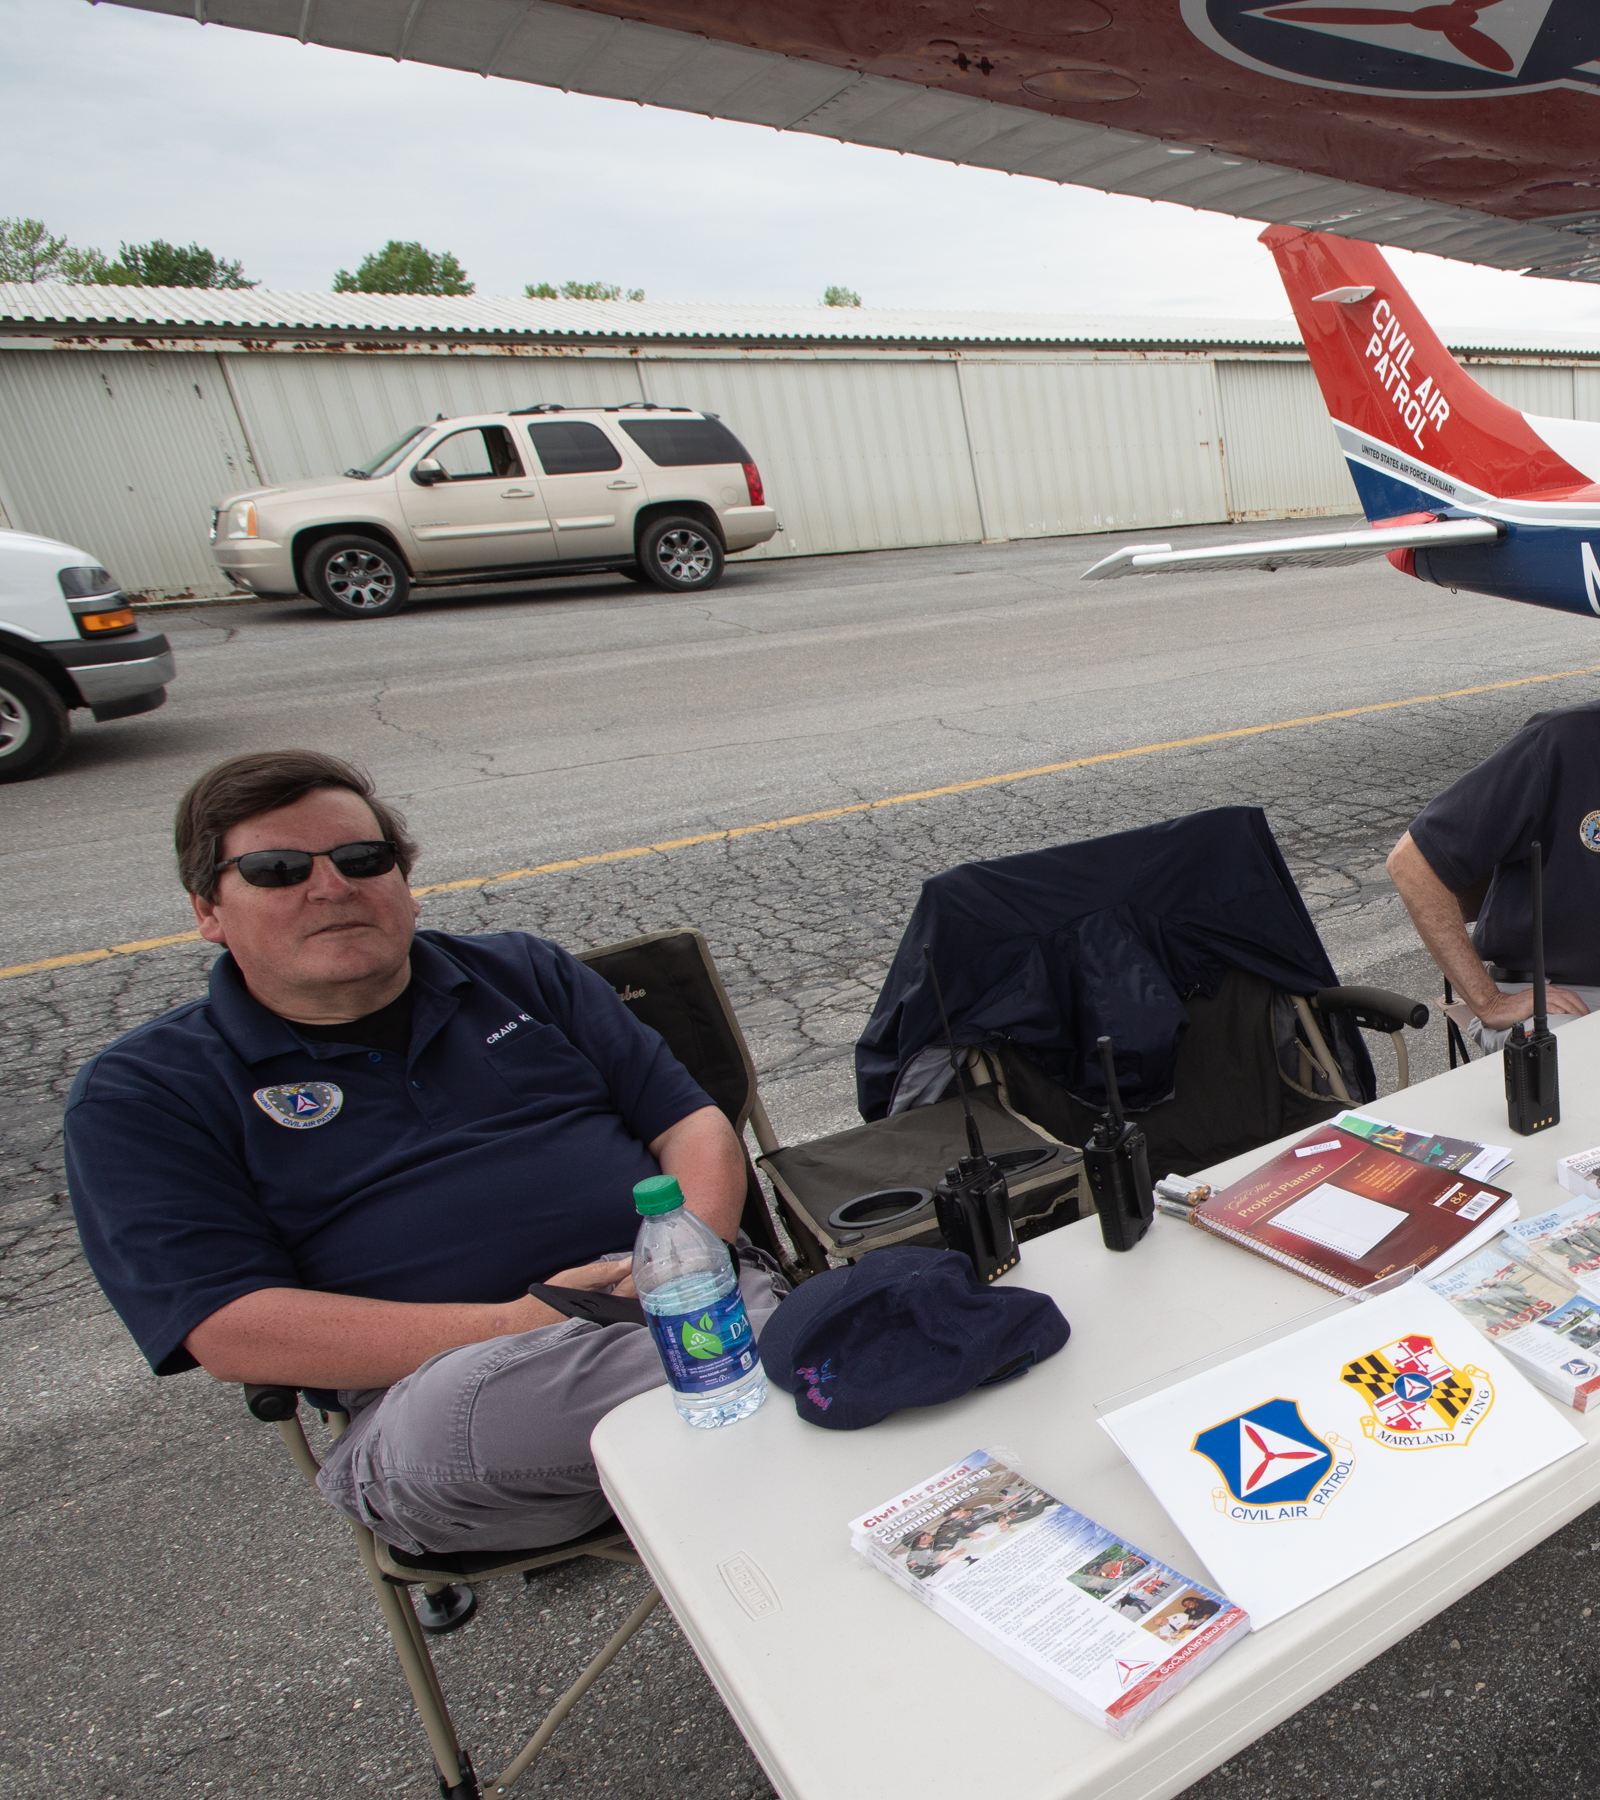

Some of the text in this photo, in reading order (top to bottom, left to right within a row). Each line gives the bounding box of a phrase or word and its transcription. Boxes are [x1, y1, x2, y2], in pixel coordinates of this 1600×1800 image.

[1372, 299, 1450, 432] CIVIL AIR
[1365, 332, 1427, 450] PATROL
[1361, 444, 1456, 496] UNITED STATES AIR FORCE AUXILIARY
[486, 1021, 518, 1044] CRAIG
[282, 1105, 340, 1128] CIVIL AIR PATROL
[1566, 1152, 1588, 1165] Civil
[1237, 1187, 1282, 1216] Project
[1278, 1162, 1324, 1191] Planner
[1449, 1191, 1467, 1204] 84
[1519, 1221, 1560, 1236] PATROL
[1429, 1272, 1467, 1290] VIL AIR
[1436, 1280, 1468, 1295] TROL
[1485, 1299, 1553, 1336] PILOTS
[1460, 1388, 1490, 1427] WING
[1377, 1430, 1455, 1446] MARYLAND
[862, 1462, 970, 1531] Civil Air Patrol
[872, 1464, 991, 1541] Citizens Serving
[1231, 1458, 1354, 1521] CIVIL AIR PATROL
[880, 1480, 979, 1548] Communities
[1159, 1612, 1238, 1675] GoCivilAirPatrol.com
